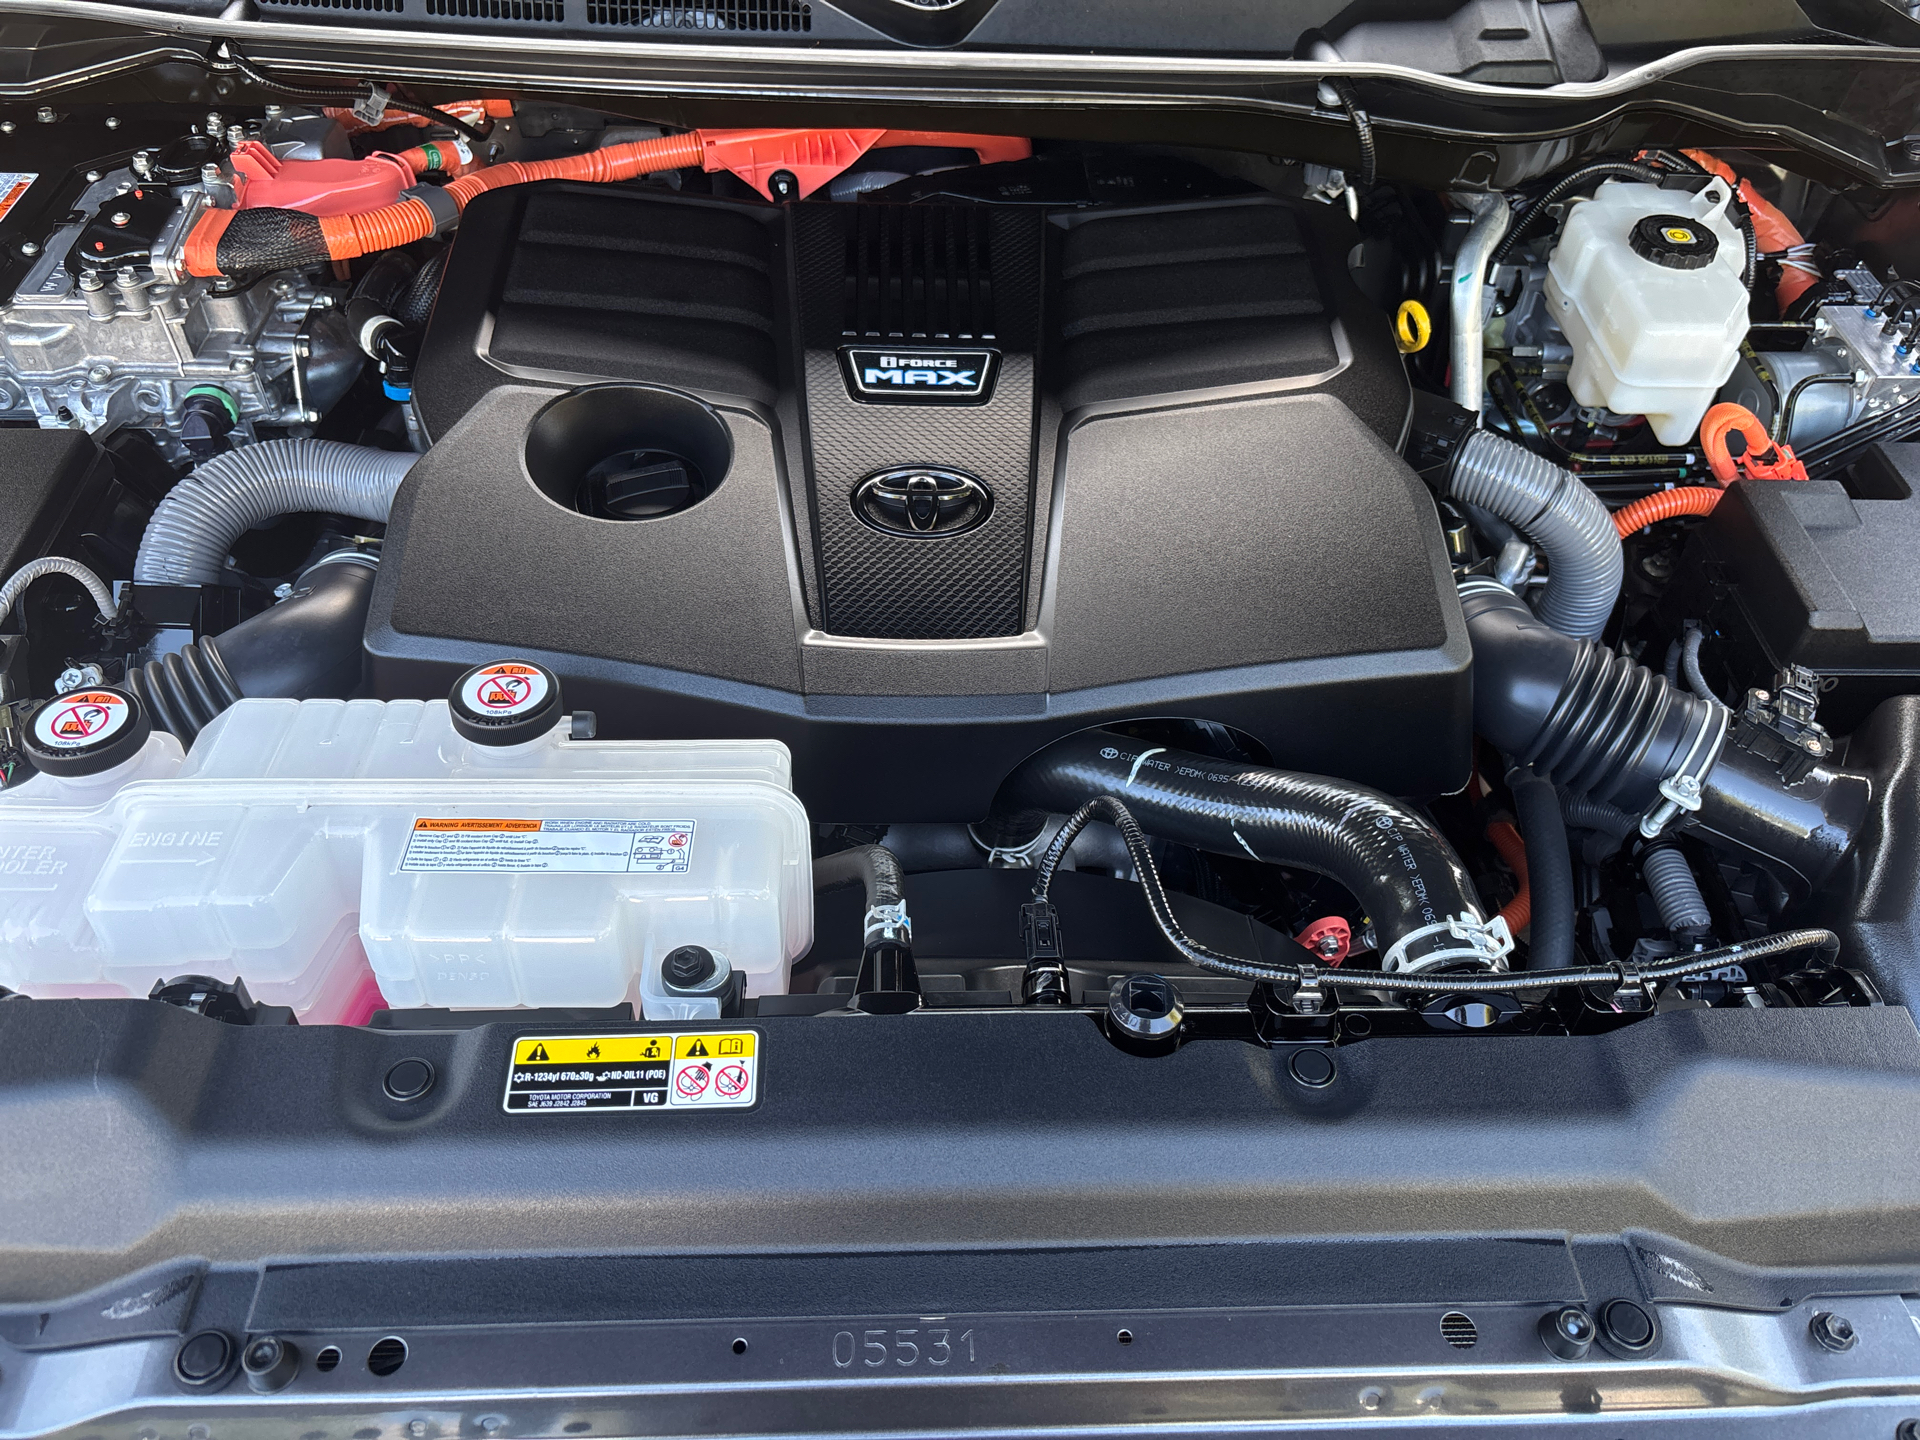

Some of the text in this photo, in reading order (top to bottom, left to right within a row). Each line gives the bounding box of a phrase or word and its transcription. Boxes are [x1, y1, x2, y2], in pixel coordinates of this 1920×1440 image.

[864, 368, 976, 386] MAX
[128, 832, 223, 847] ENGINE
[1387, 827, 1403, 842] CIP
[1397, 844, 1416, 871] WATER
[0, 860, 68, 874] OLER
[524, 1070, 666, 1082] R-1234yf 670±30g ND-OIL11 (POE)
[643, 1092, 658, 1103] VG
[832, 1329, 974, 1368] 05531
